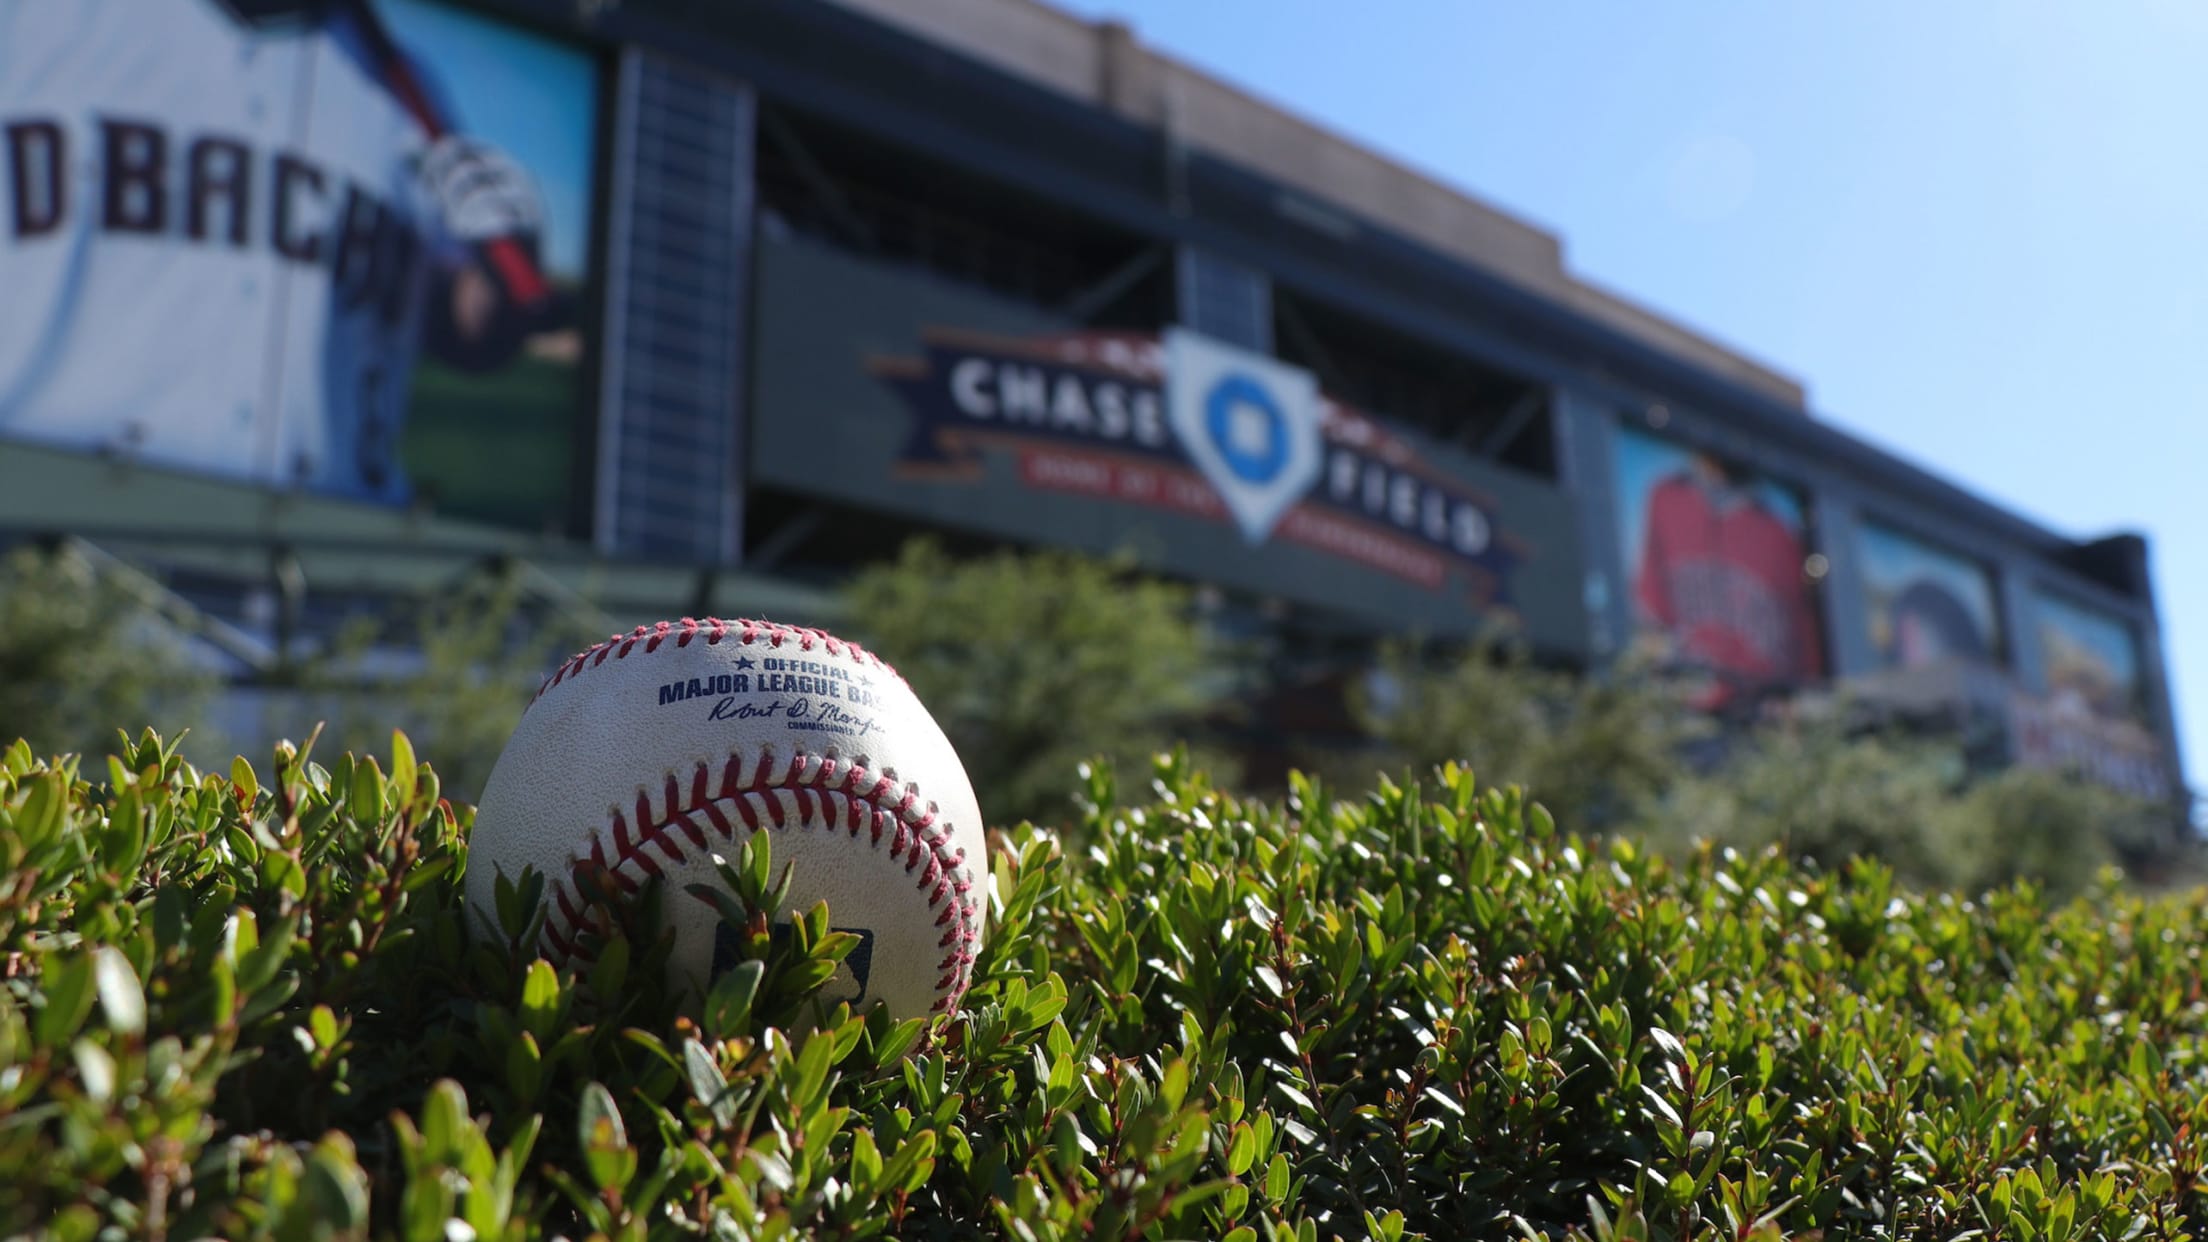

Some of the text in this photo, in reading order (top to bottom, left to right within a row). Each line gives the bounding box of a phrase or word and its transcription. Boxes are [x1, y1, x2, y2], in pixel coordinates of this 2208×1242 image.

[950, 356, 1165, 443] CHASE
[1329, 449, 1491, 557] FIELD
[763, 657, 853, 682] OFFICIAL
[658, 674, 749, 706] MAJOR
[757, 673, 841, 699] LEAGUE
[787, 720, 857, 737] COMMISSIONER
